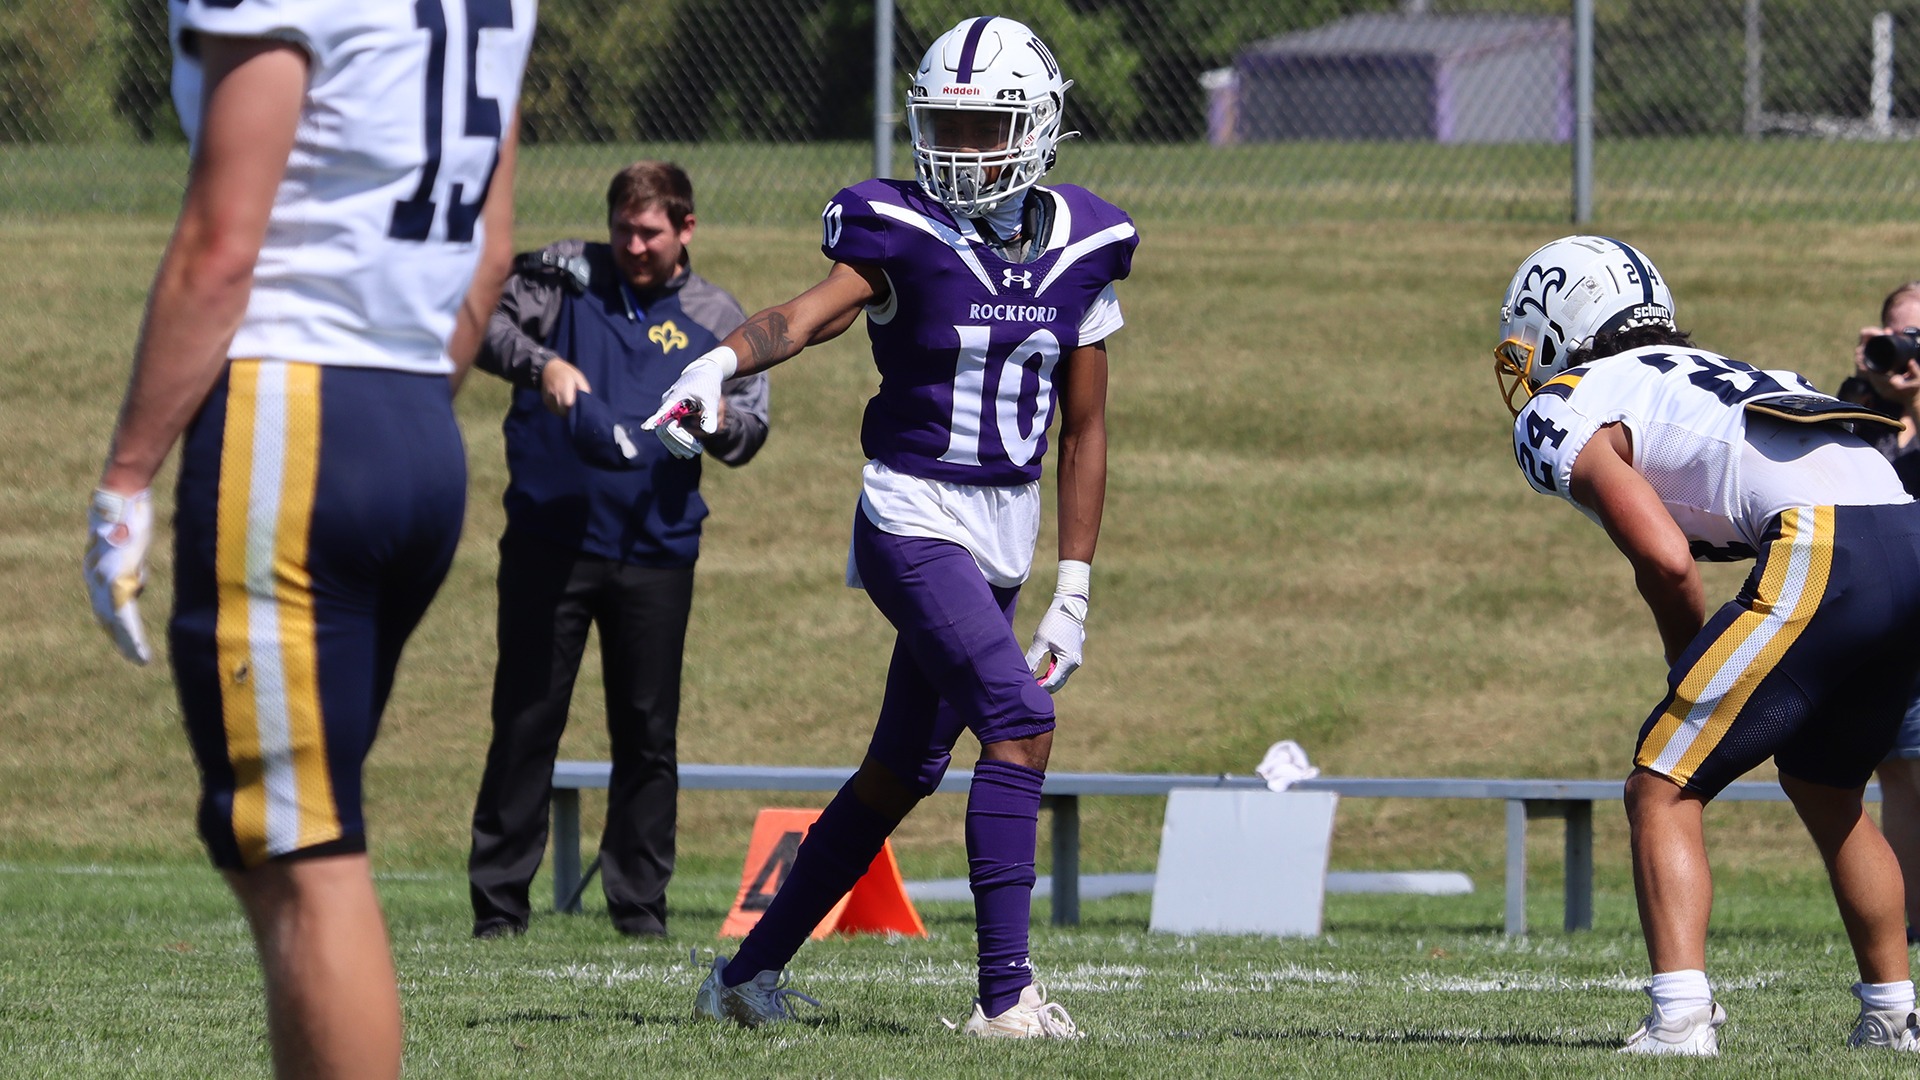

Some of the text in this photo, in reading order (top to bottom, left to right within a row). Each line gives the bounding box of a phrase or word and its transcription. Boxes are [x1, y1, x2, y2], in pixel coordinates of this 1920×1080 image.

[1026, 37, 1057, 80] 10
[943, 86, 980, 96] Riddell
[387, 0, 513, 242] 15
[822, 200, 843, 248] 10
[969, 303, 1058, 323] ROCKFORD
[936, 325, 1060, 467] 10
[1518, 409, 1569, 492] 24
